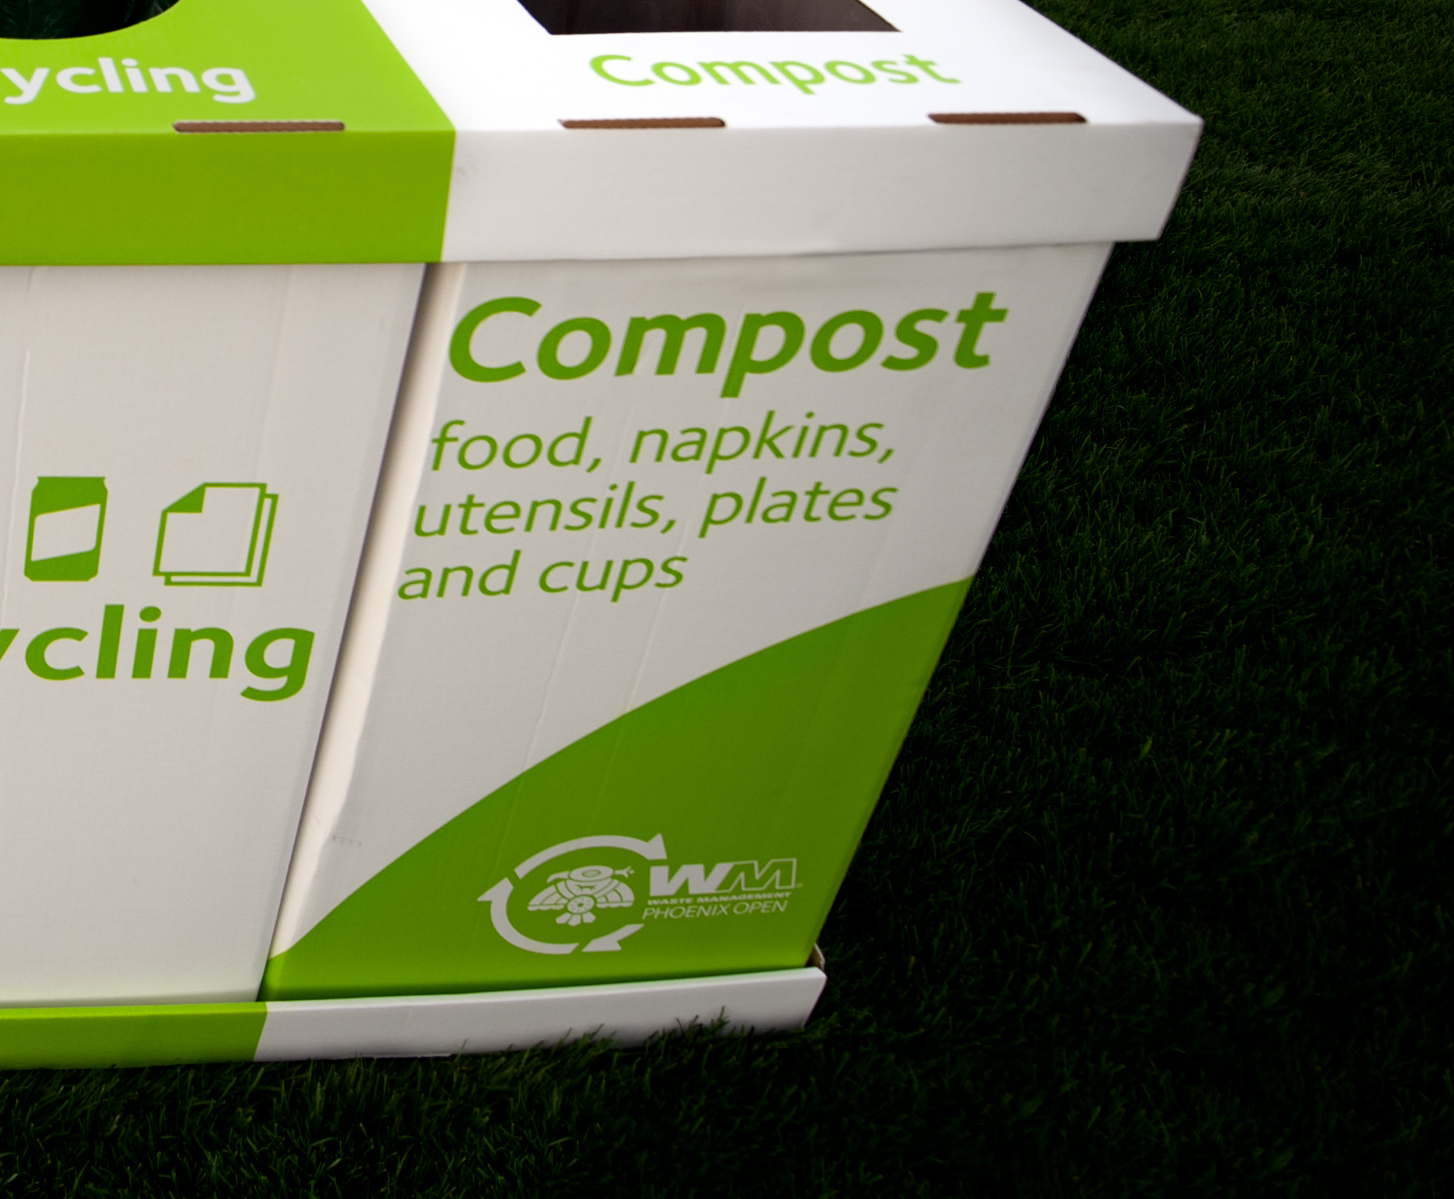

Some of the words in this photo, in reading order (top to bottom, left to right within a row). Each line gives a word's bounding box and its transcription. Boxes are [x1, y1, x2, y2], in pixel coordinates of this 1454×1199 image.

[591, 55, 958, 94] Compost
[450, 293, 1007, 398] Compost
[433, 417, 600, 472] food,
[631, 411, 893, 474] napkins,
[415, 482, 675, 537] utensils,
[700, 477, 897, 538] plates
[399, 550, 521, 600] and
[540, 557, 687, 602] cups
[642, 904, 730, 920] PHOENIX
[733, 900, 788, 915] OPEN
[697, 892, 791, 903] MANAGEMENT
